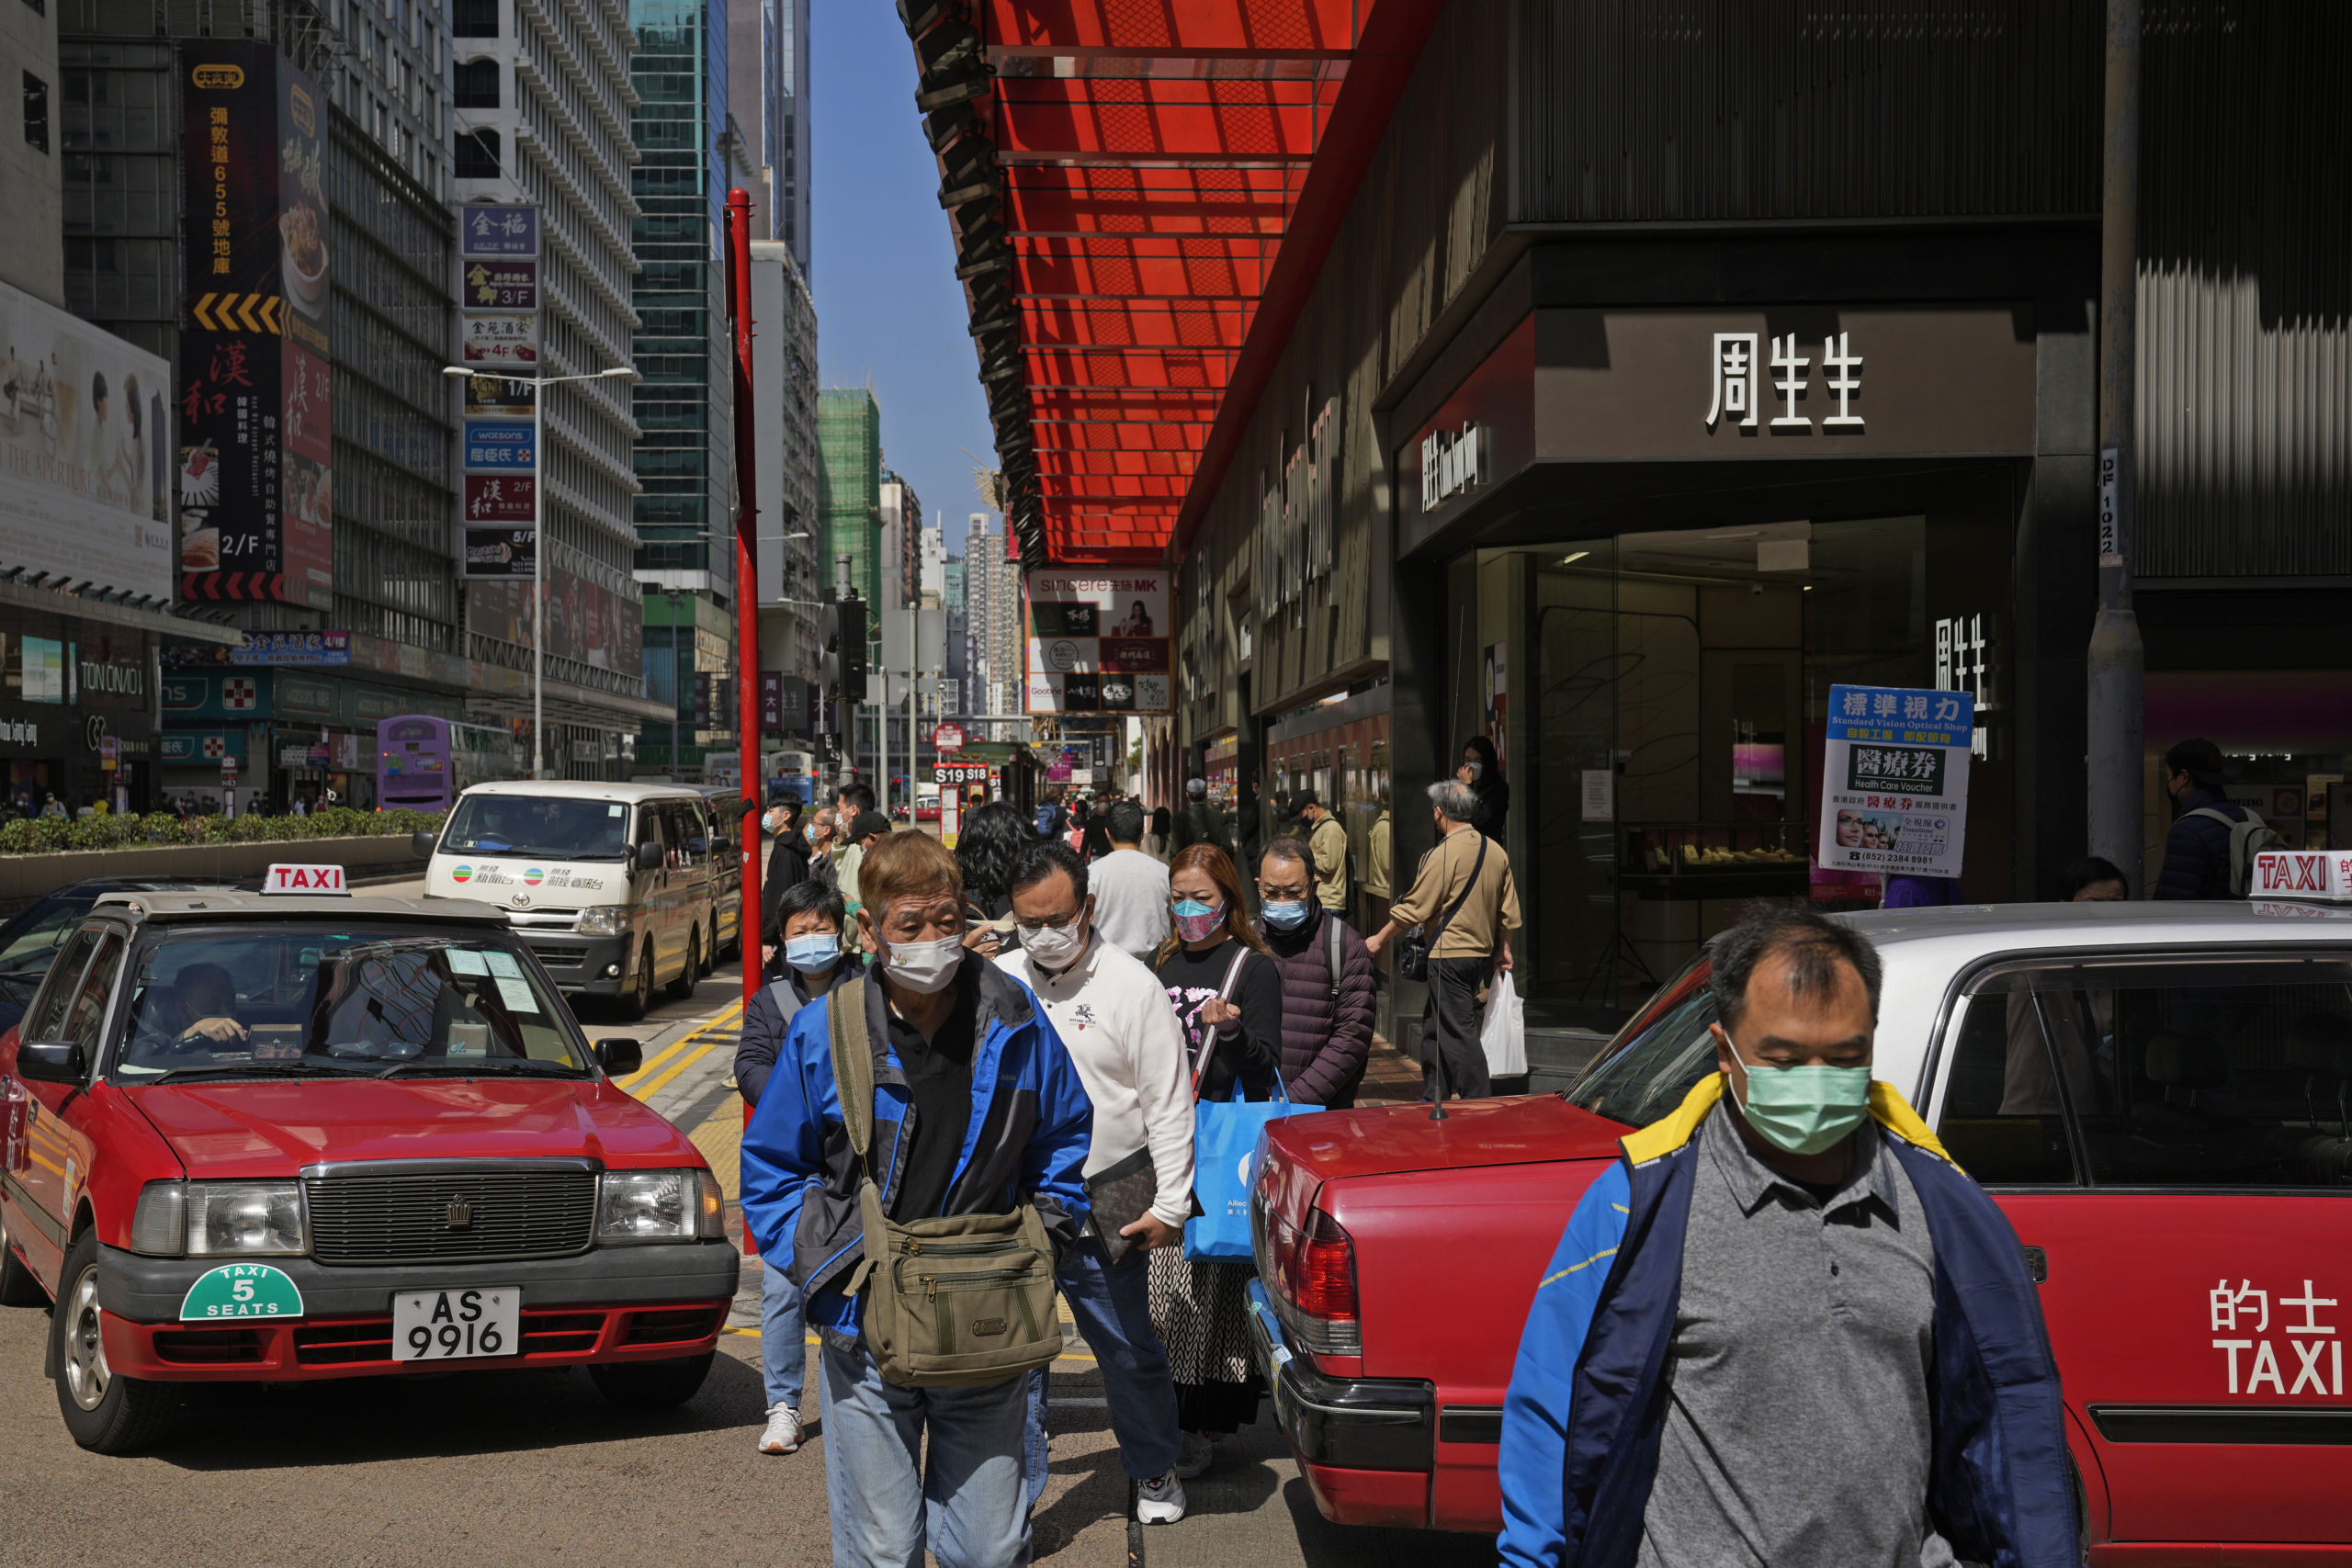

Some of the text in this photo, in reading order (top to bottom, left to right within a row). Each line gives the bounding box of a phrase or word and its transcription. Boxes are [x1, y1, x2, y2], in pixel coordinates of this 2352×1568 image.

[209, 107, 230, 275] 彌敦道655號地庫
[502, 291, 528, 305] 3/F
[492, 344, 510, 357] 4F
[316, 372, 330, 403] 2/F
[1704, 332, 1866, 426] 周生生
[237, 396, 248, 445] 韓國料理
[478, 430, 523, 440] watsons
[470, 448, 512, 462] 屈臣氏
[35, 454, 96, 496] APERTURE
[2103, 459, 2114, 487] DF
[514, 482, 531, 492] 2/F
[2101, 496, 2113, 553] 1022
[221, 534, 259, 557] 2/F
[1040, 579, 1158, 592] sincere 先施 MK
[1935, 611, 1986, 712] 周生生
[765, 679, 777, 724] 周大福
[1843, 692, 1960, 721] 標準視力
[1832, 716, 1968, 733] Standard Vision Optical Shop
[1848, 728, 1951, 744] 自設工場 即配即有
[967, 768, 986, 780] S18
[1857, 748, 1937, 779] 醫療券
[935, 768, 965, 783] S19
[989, 778, 1001, 787] S1
[1854, 778, 1934, 793] Health Care Voucher
[1867, 795, 1913, 810] 醫療券
[1862, 852, 1933, 864] (852) 2384 8981
[275, 868, 340, 888] TAXI
[2258, 855, 2326, 891] TAXI
[219, 1267, 268, 1279] TAXI
[232, 1280, 255, 1302] 5
[207, 1303, 278, 1316] SEATS
[431, 1291, 483, 1324] AS
[2210, 1279, 2338, 1335] 的士
[408, 1322, 503, 1359] 9916
[2212, 1339, 2343, 1394] TAXI
